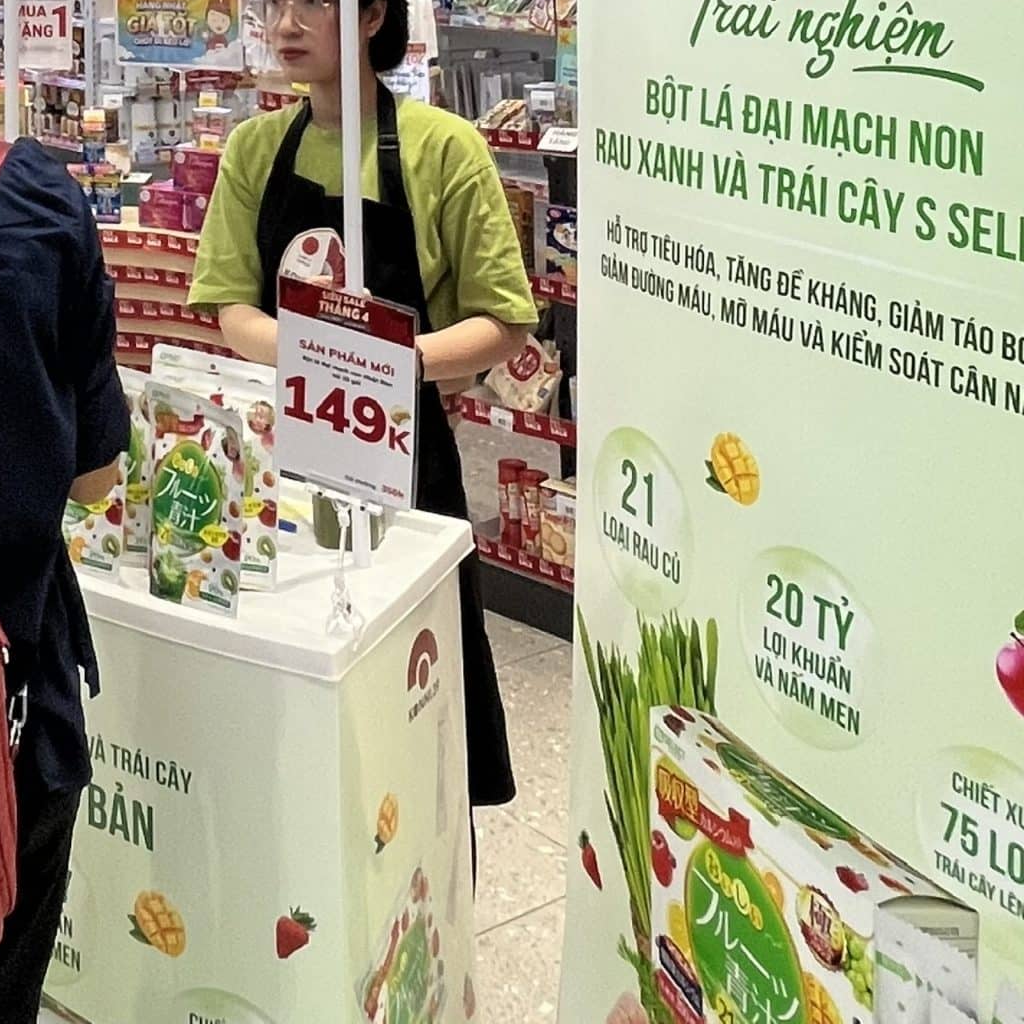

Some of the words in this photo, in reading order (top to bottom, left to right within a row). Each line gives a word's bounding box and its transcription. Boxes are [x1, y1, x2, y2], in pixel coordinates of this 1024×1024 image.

[21, 21, 53, 41] ẶNG
[646, 76, 693, 125] BỘT
[700, 83, 734, 131] LÁ
[742, 93, 792, 145] ĐẠI
[803, 103, 897, 160] MẠCH
[908, 119, 985, 177] NON
[596, 127, 632, 171] RAU
[638, 138, 704, 190] XANH
[712, 149, 749, 201] VÀ
[758, 163, 828, 218] TRÁI
[837, 177, 906, 234] CÂY
[915, 196, 937, 241] S
[318, 300, 361, 320] THÁNG
[606, 214, 623, 246] HỖ
[624, 224, 649, 256] TRỢ
[651, 233, 681, 267] TIÊU
[684, 243, 721, 282] HÓA,
[726, 254, 772, 293] TĂNG
[776, 268, 804, 302] ĐỀ
[808, 278, 883, 328] KHÁNG,
[888, 299, 946, 343] GIẢM
[950, 312, 994, 356] TÁO
[299, 337, 325, 355] SẢN
[329, 348, 367, 368] PHẨM
[370, 361, 395, 377] MỚI
[600, 252, 629, 286] GIẢM
[631, 262, 675, 305] ĐƯỜNG
[677, 281, 716, 322] MÁU,
[720, 292, 749, 330] MỠ
[751, 303, 794, 343] MÁU
[799, 320, 826, 353] VÀ
[830, 328, 883, 372] KIỂM
[888, 346, 944, 389] SOÁT
[949, 365, 998, 407] CÂN
[621, 458, 654, 528] 21
[603, 511, 630, 553] LOẠI
[632, 533, 660, 572] RAU
[662, 549, 681, 585] CỦ
[765, 573, 804, 629] 20
[812, 595, 855, 652] TỶ
[754, 653, 775, 690] VÀ
[778, 670, 815, 712] NẤM
[819, 692, 861, 737] MEN
[763, 625, 788, 660] LỢI
[790, 641, 852, 695] KHUẨN
[110, 742, 150, 780] TRÁI
[154, 760, 193, 795] CÂY
[952, 771, 1001, 814] CHIẾT
[87, 780, 154, 852] BẢN
[941, 801, 979, 857] 75
[934, 849, 965, 884] TRÁI
[968, 872, 996, 902] CÂY
